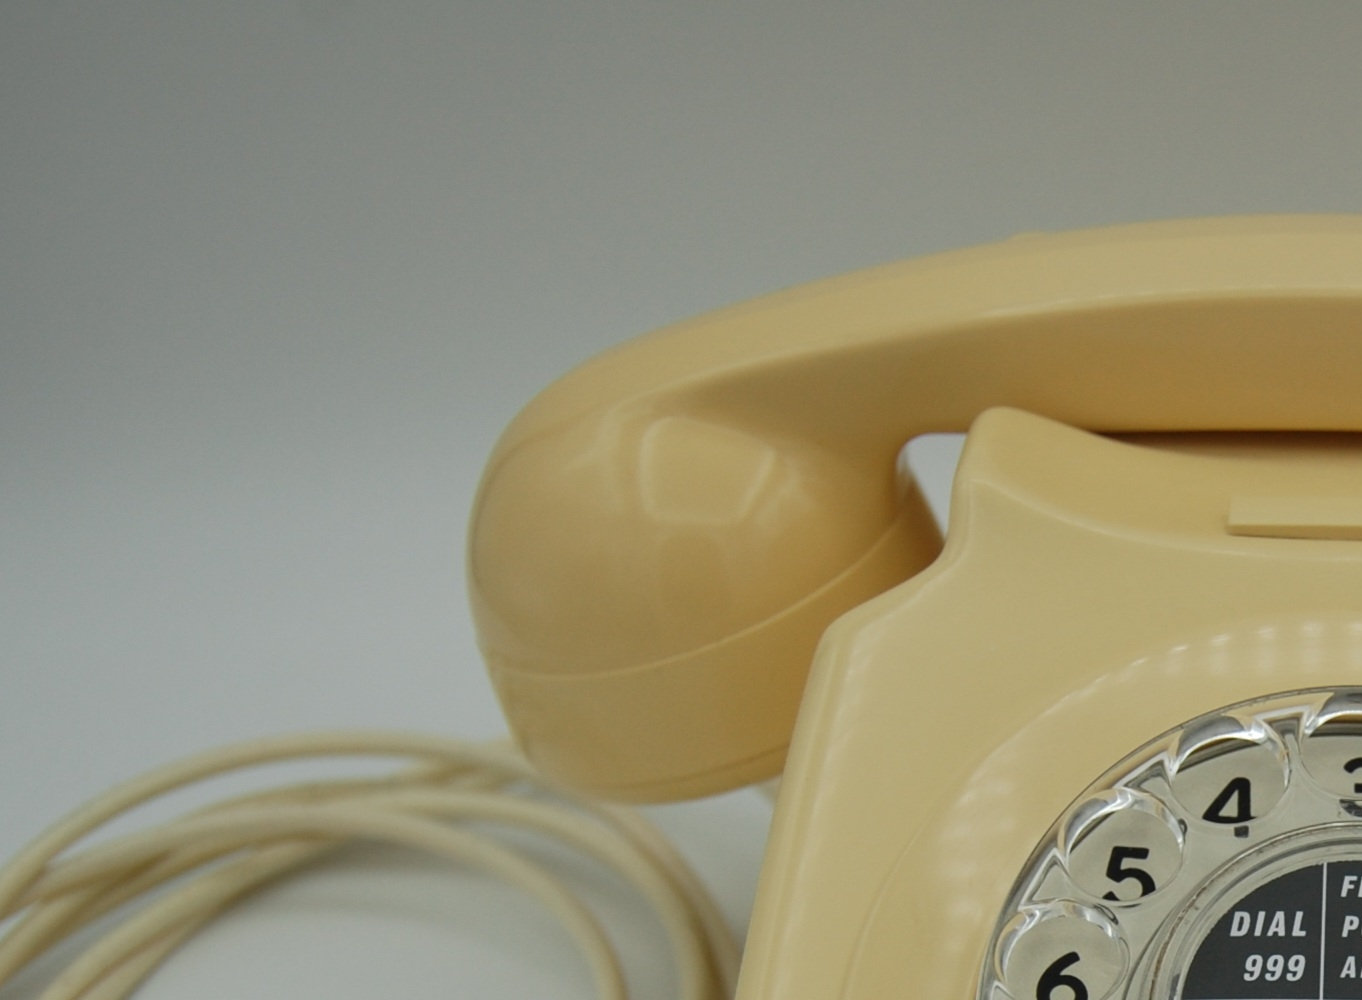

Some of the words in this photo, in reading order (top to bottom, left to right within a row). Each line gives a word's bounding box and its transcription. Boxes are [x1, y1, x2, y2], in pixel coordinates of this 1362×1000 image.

[1202, 777, 1256, 837] 4
[1102, 846, 1157, 902] 5
[1229, 911, 1307, 937] DIAL
[1243, 954, 1306, 982] 999
